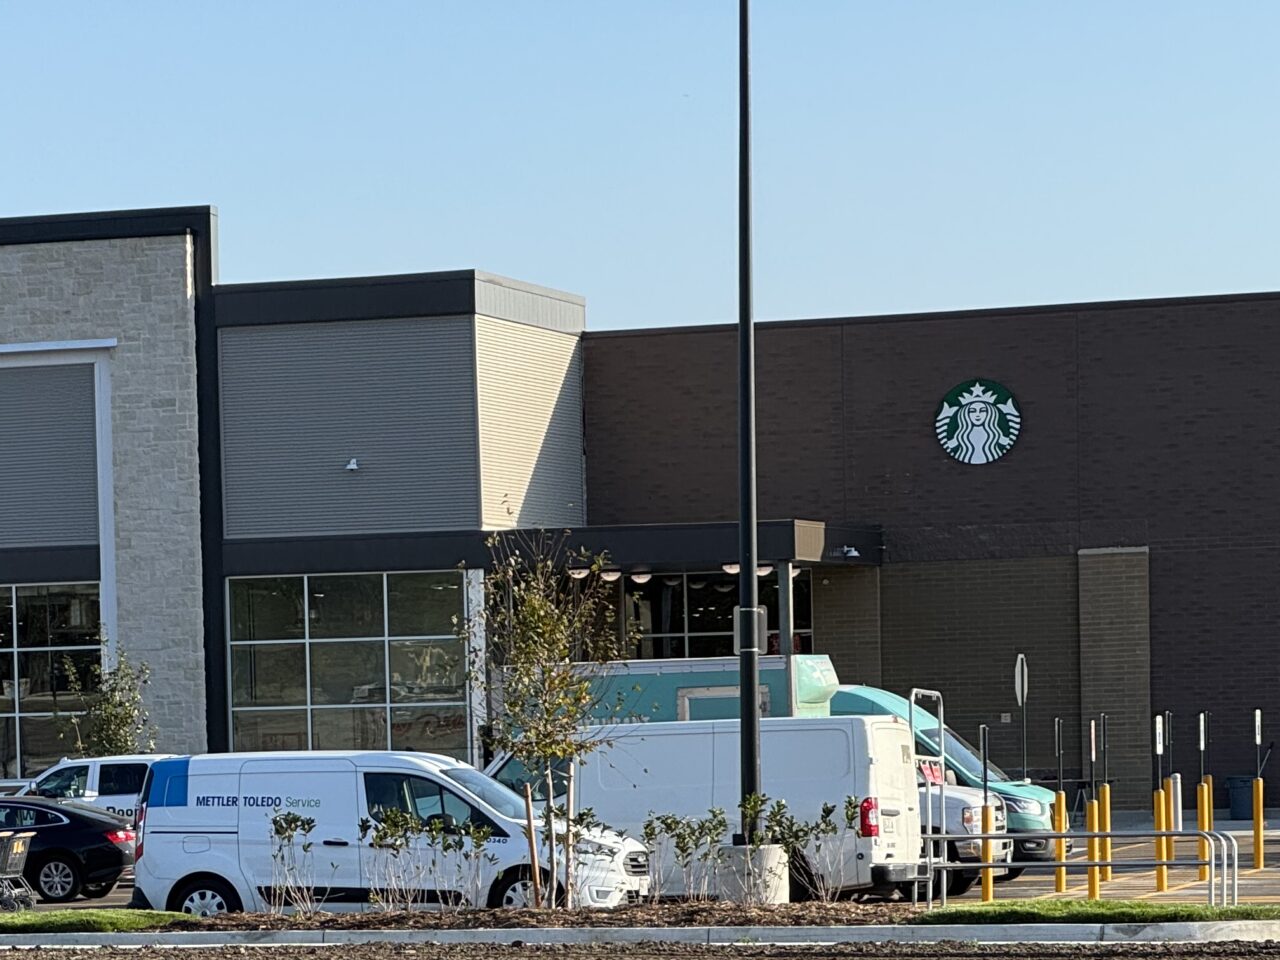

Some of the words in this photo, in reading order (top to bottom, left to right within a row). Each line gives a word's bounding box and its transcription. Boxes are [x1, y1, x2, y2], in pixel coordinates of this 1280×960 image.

[196, 796, 238, 807] METTLER
[243, 796, 281, 807] TOLEDO
[285, 796, 320, 808] Service
